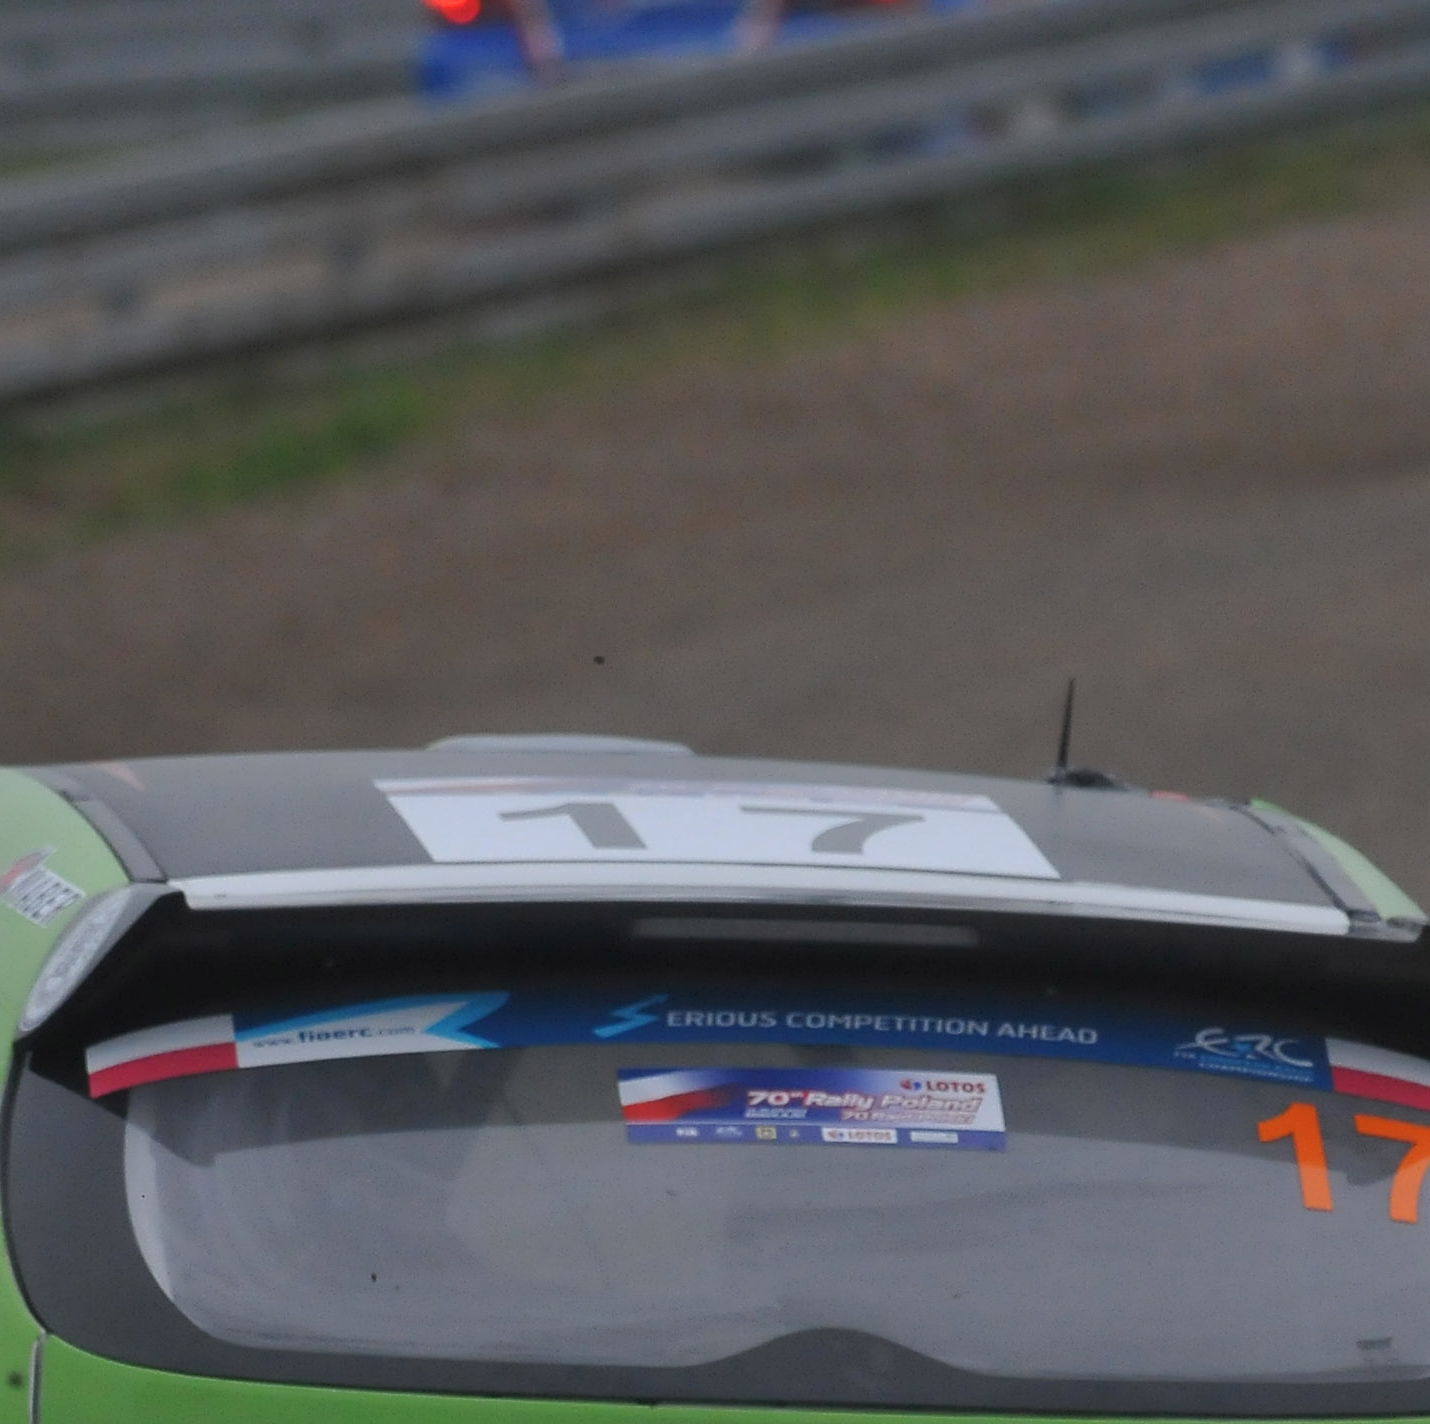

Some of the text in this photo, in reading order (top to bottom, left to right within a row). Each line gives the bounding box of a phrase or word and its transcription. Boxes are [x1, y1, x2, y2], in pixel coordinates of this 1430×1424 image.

[497, 802, 927, 856] 17
[785, 1011, 989, 1037] COMPETITION
[996, 1022, 1098, 1045] AHEAD
[926, 1080, 985, 1094] LOTOS
[803, 1092, 874, 1111] Rally
[881, 1095, 983, 1112] Poland
